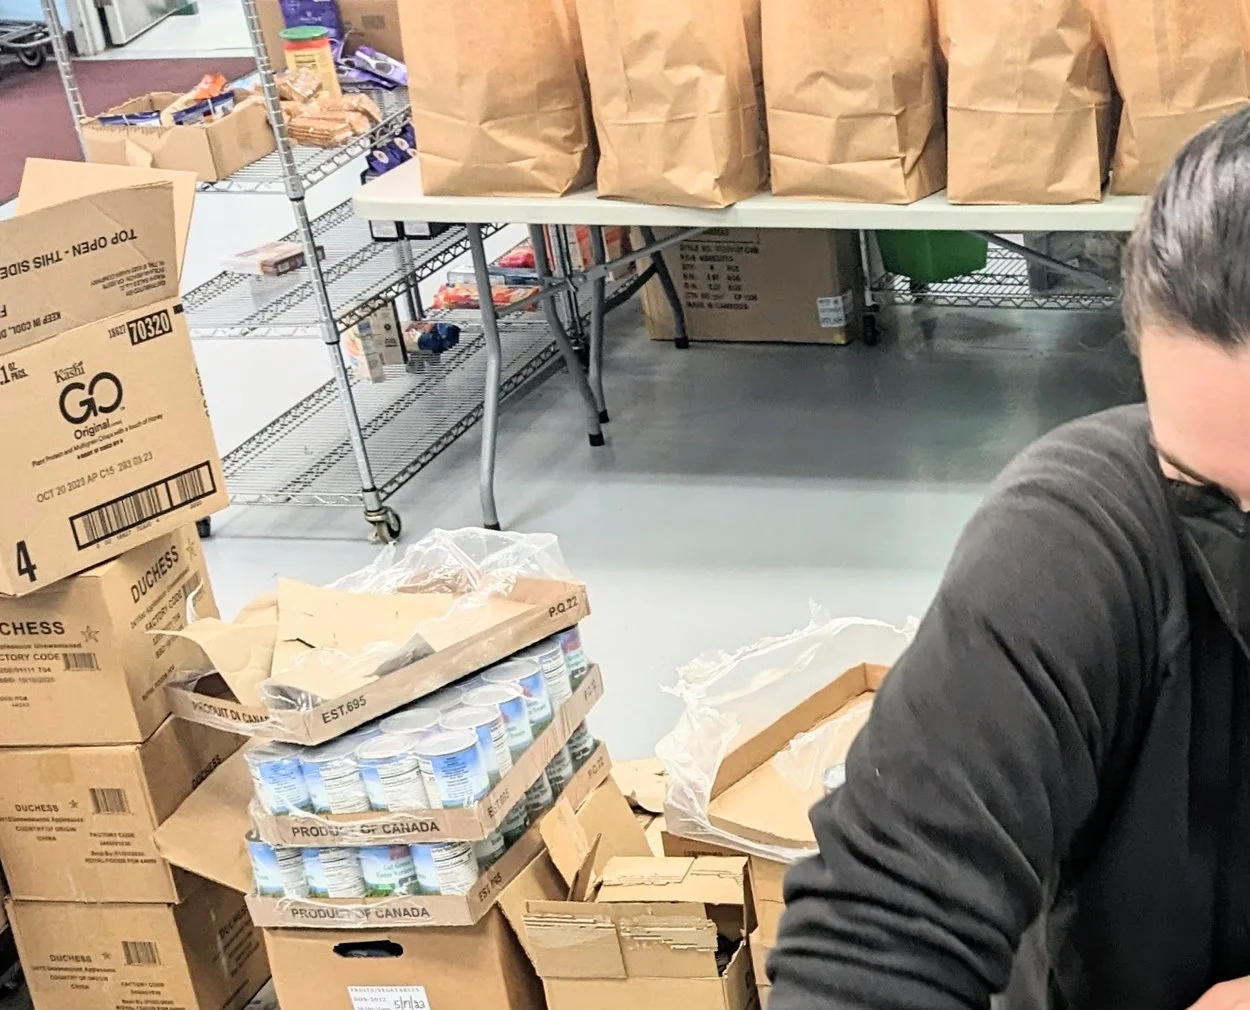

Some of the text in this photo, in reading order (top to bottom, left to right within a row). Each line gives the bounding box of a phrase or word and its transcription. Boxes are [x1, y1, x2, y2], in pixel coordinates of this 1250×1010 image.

[72, 236, 108, 258] OPEN
[110, 228, 138, 246] TOP
[0, 259, 30, 280] SIDE
[32, 252, 63, 270] THIS
[45, 311, 62, 326] KEEP
[129, 311, 172, 345] 70320
[53, 360, 85, 384] Kashi
[59, 371, 124, 425] GO
[73, 419, 111, 440] Original
[37, 489, 55, 503] OCT
[56, 484, 67, 495] 20
[87, 472, 99, 483] AP
[16, 540, 37, 583] 4
[130, 545, 180, 603] DUCHESS
[547, 595, 579, 618] P.Q.22
[34, 652, 61, 661] CODE
[321, 694, 367, 724] EST.695
[15, 803, 59, 812] DUCHESS
[380, 821, 440, 836] CANADA
[375, 905, 431, 920] CANADA
